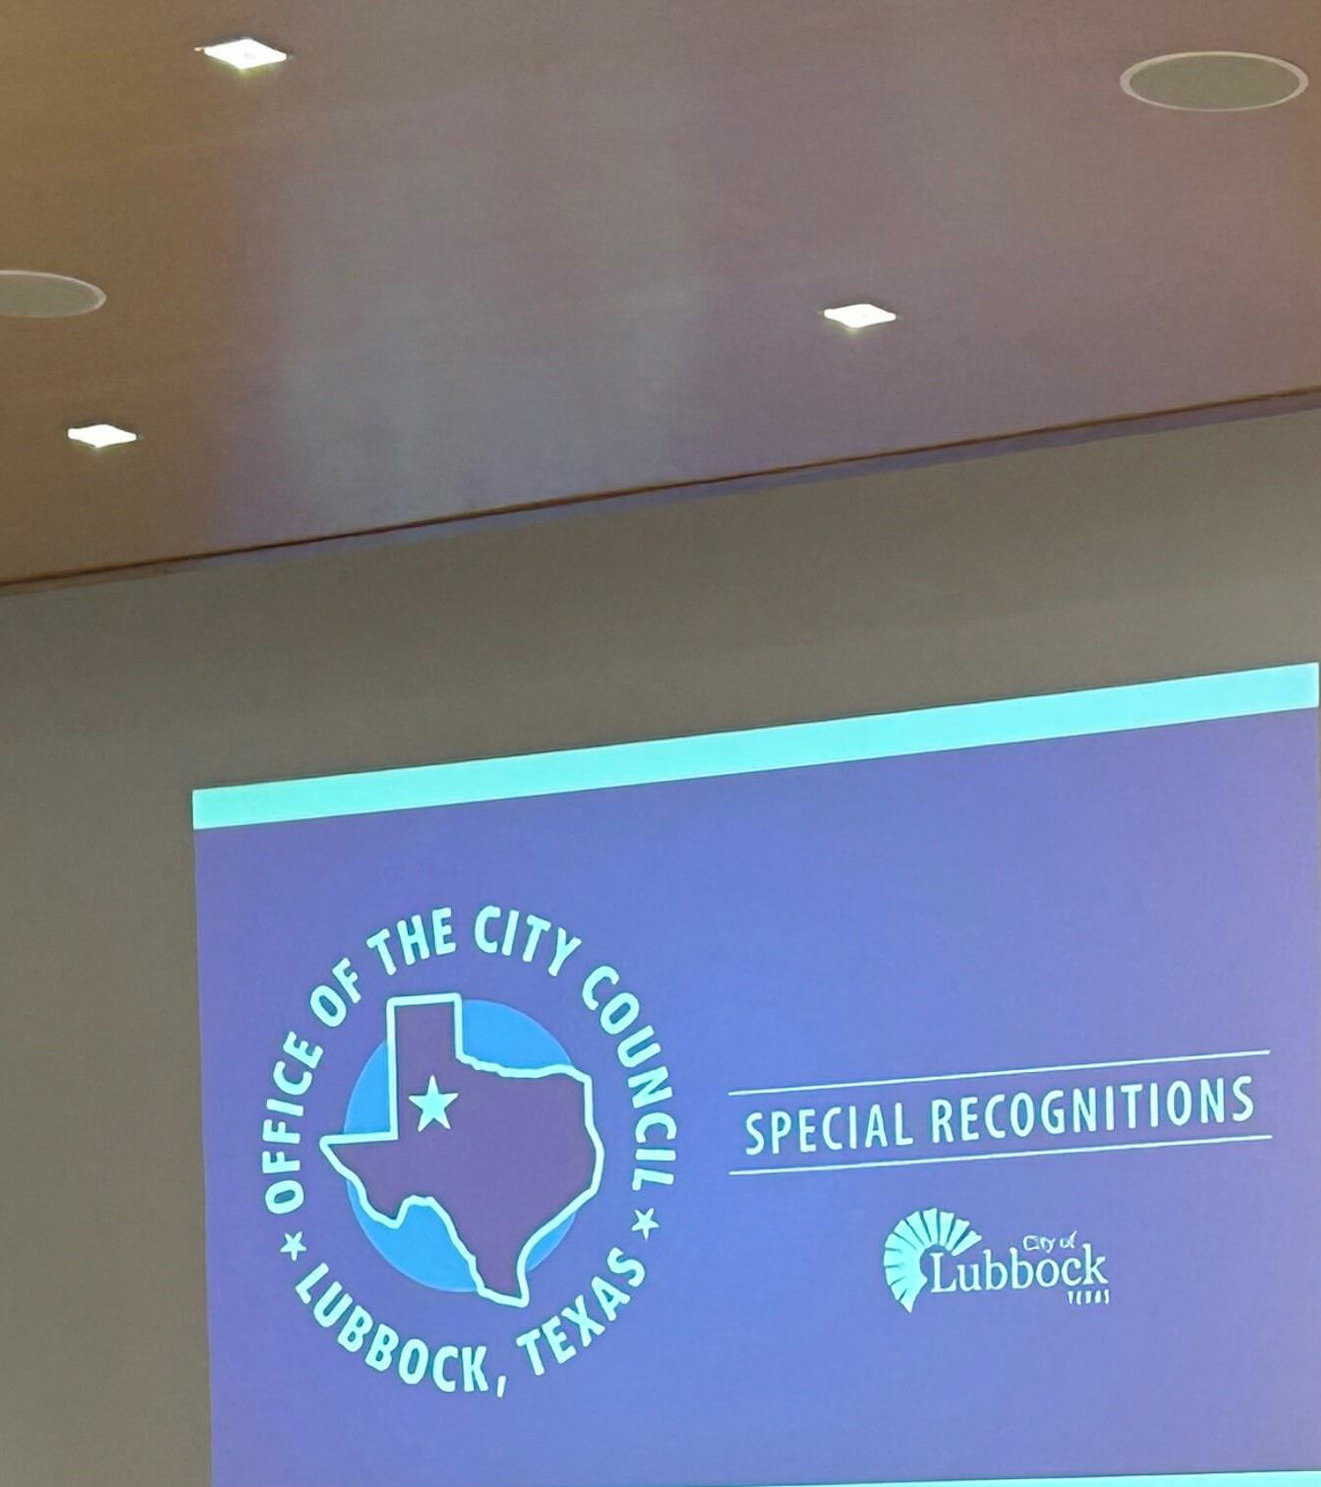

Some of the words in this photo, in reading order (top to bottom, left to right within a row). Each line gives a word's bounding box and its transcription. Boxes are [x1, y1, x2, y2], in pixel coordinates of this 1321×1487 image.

[261, 1031, 324, 1215] OFFICE
[309, 957, 362, 1028] OF
[366, 906, 457, 976] THE
[473, 904, 582, 977] CITY
[581, 964, 677, 1192] COUNCIL
[745, 1102, 914, 1156] SPECIAL
[931, 1075, 1256, 1144] RECOGNITIONS
[294, 1262, 507, 1398] LUBBOCK,
[515, 1246, 646, 1377] TEXAS
[930, 1243, 1109, 1293] Lubbock
